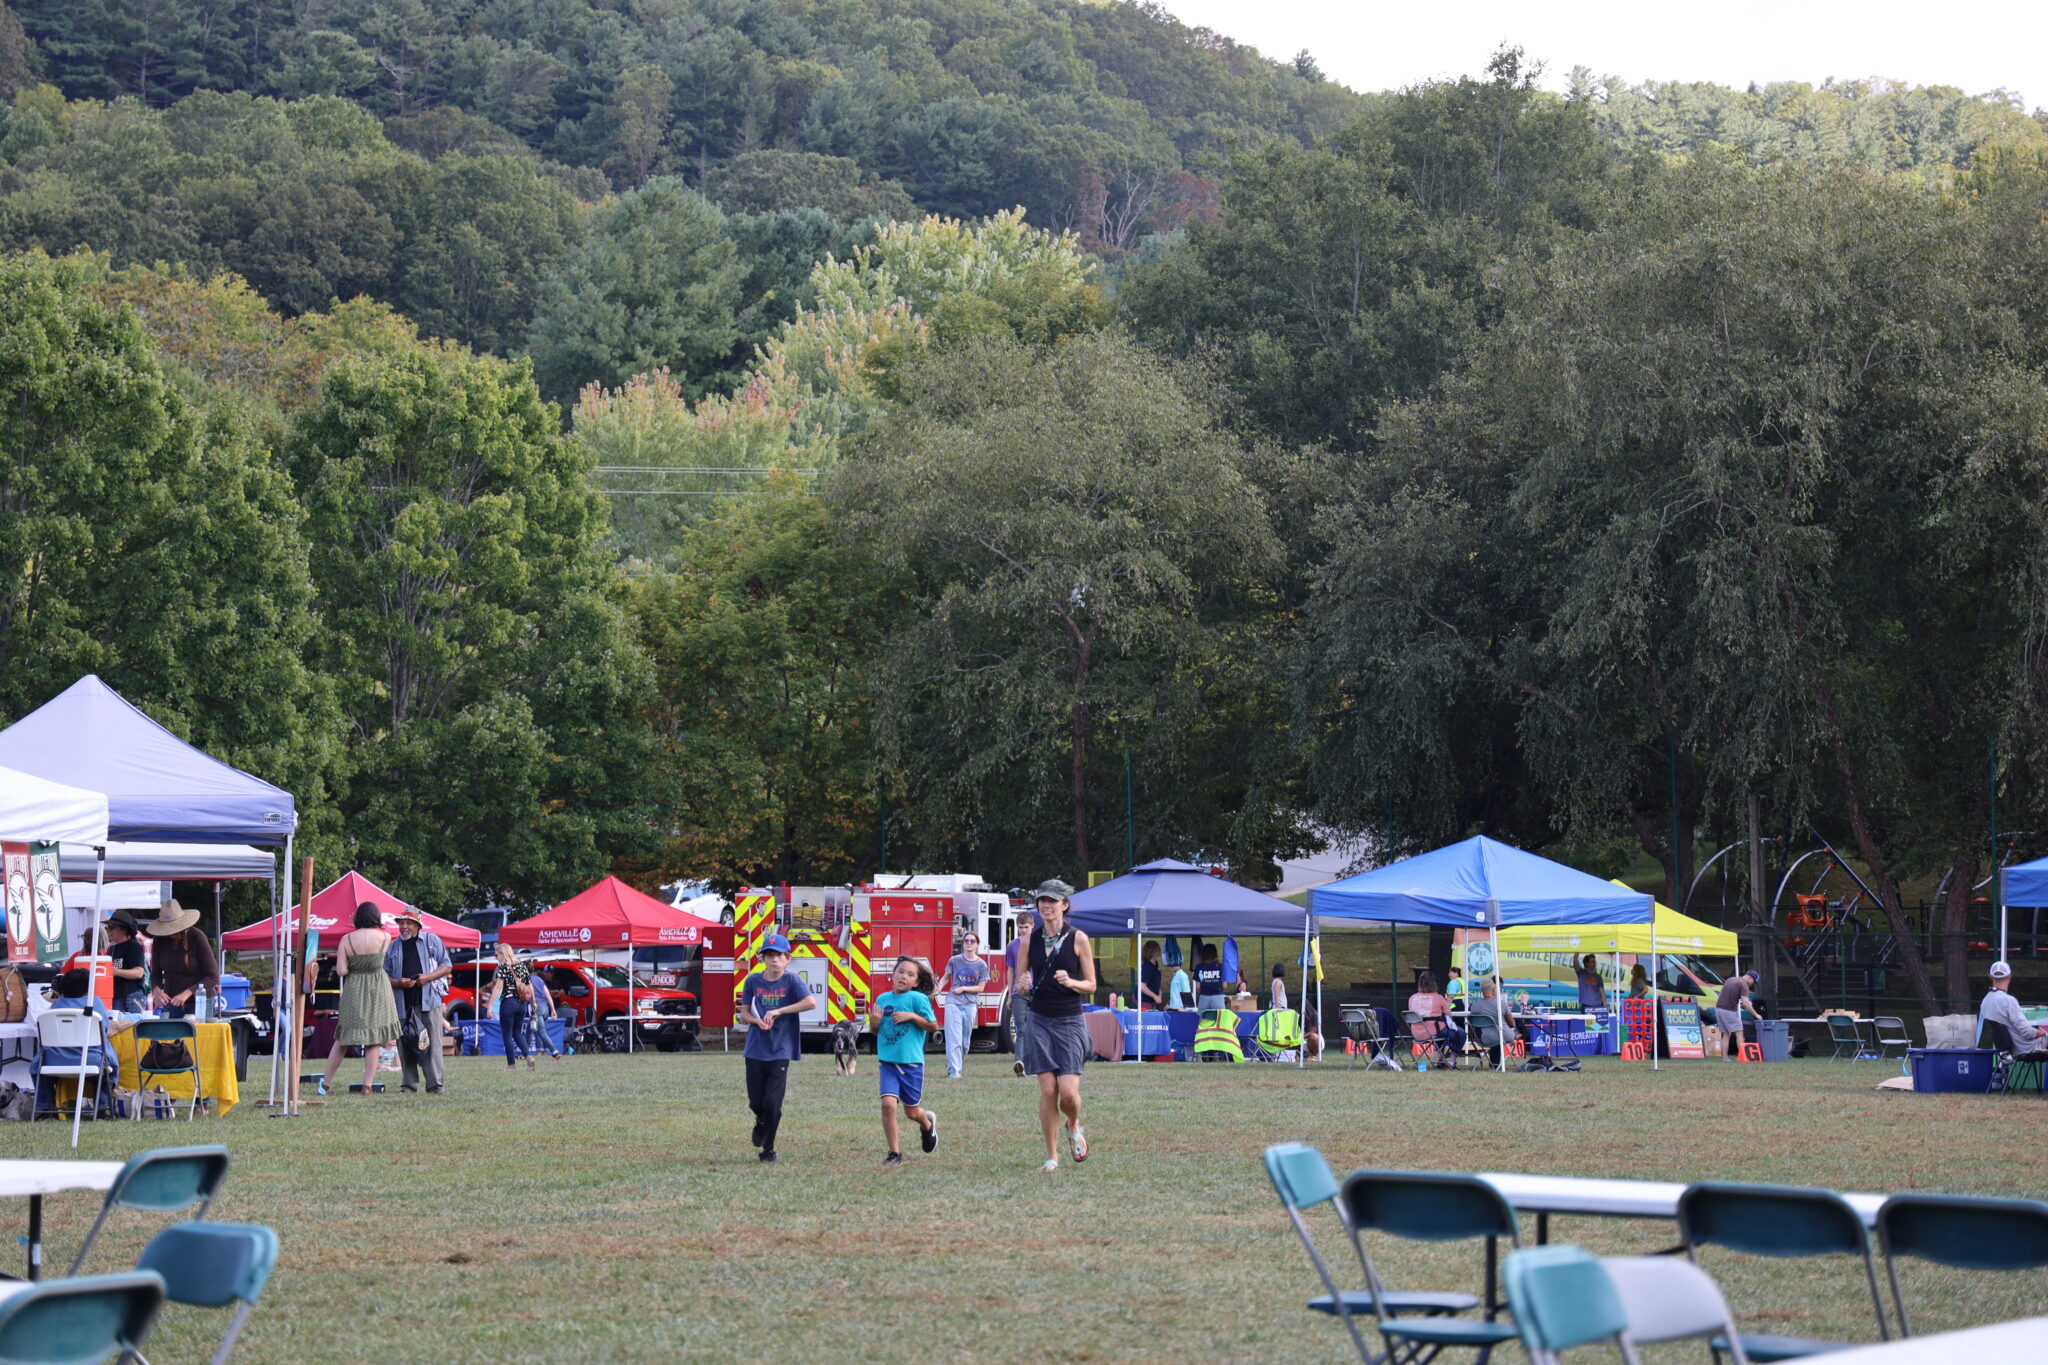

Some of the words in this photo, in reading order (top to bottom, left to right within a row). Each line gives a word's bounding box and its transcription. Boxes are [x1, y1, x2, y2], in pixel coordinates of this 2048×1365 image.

[538, 928, 579, 939] ASHEVILLE
[658, 927, 689, 936] ASHEVILLE
[1203, 970, 1221, 979] CAPE
[650, 975, 676, 986] VENDOR
[756, 987, 786, 997] PEACE
[761, 997, 780, 1006] OUT
[1552, 1001, 1564, 1009] GET
[1667, 1015, 1697, 1024] TODAY
[1510, 1042, 1523, 1057] 20
[1627, 1044, 1643, 1060] 10
[1744, 1044, 1760, 1061] G
